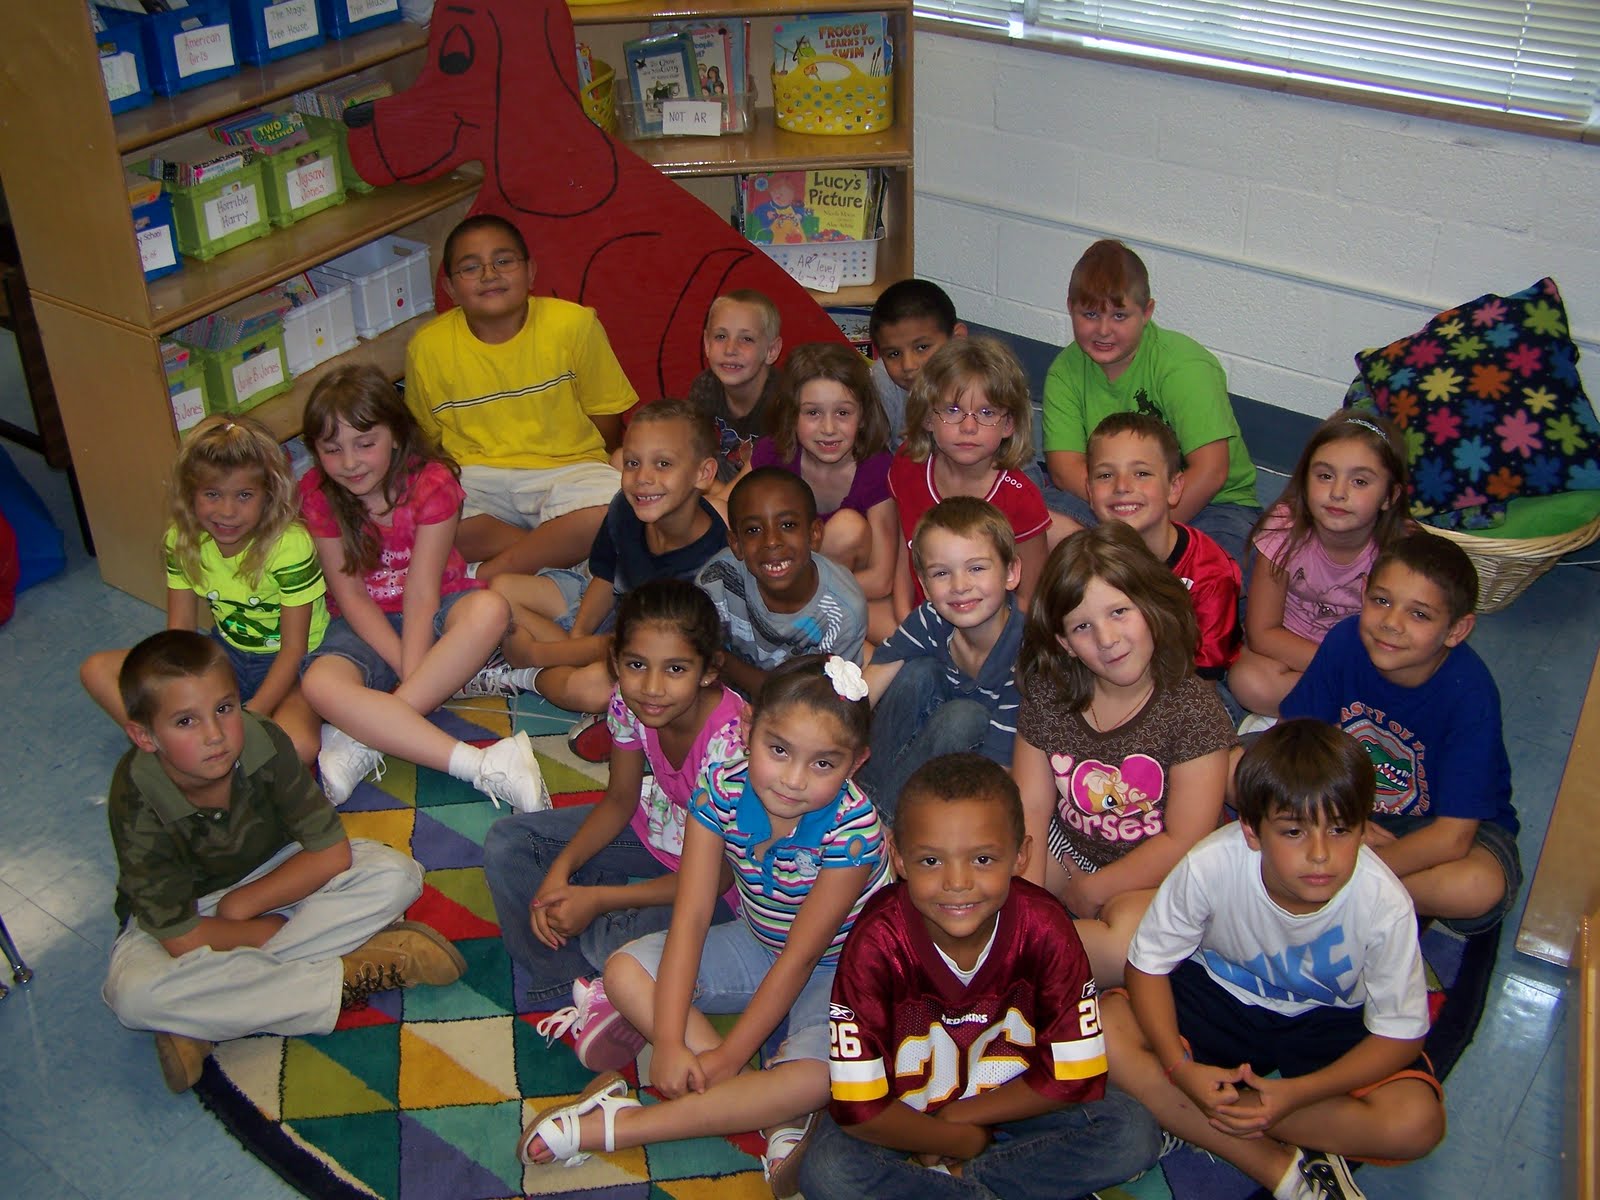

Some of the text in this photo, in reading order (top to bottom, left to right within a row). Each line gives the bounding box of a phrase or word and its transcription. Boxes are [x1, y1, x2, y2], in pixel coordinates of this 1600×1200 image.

[271, 4, 306, 20] The Magic
[270, 22, 309, 40] Tree House
[818, 23, 869, 39] FROGGY
[185, 31, 222, 49] American
[825, 35, 876, 49] LEARNS TO
[189, 53, 209, 66] Girls
[832, 47, 865, 59] SWIM
[669, 112, 707, 123] NOT AR
[256, 121, 282, 137] TWO
[266, 126, 296, 141] kind
[296, 167, 326, 188] Jigsaw
[813, 171, 862, 191] Lucy's
[301, 184, 325, 201] Jones
[808, 189, 863, 208] Picture
[216, 194, 249, 214] Horrible
[221, 211, 249, 228] Harry
[143, 230, 162, 241] School
[816, 259, 836, 276] level
[818, 275, 836, 289] 2.9
[260, 361, 280, 380] Jones
[182, 401, 204, 420] Jones
[1341, 701, 1431, 816] ASTY OF FLORIDA
[1077, 996, 1102, 1037] 2
[829, 1021, 862, 1058] 26
[895, 1007, 1036, 1110] 26
